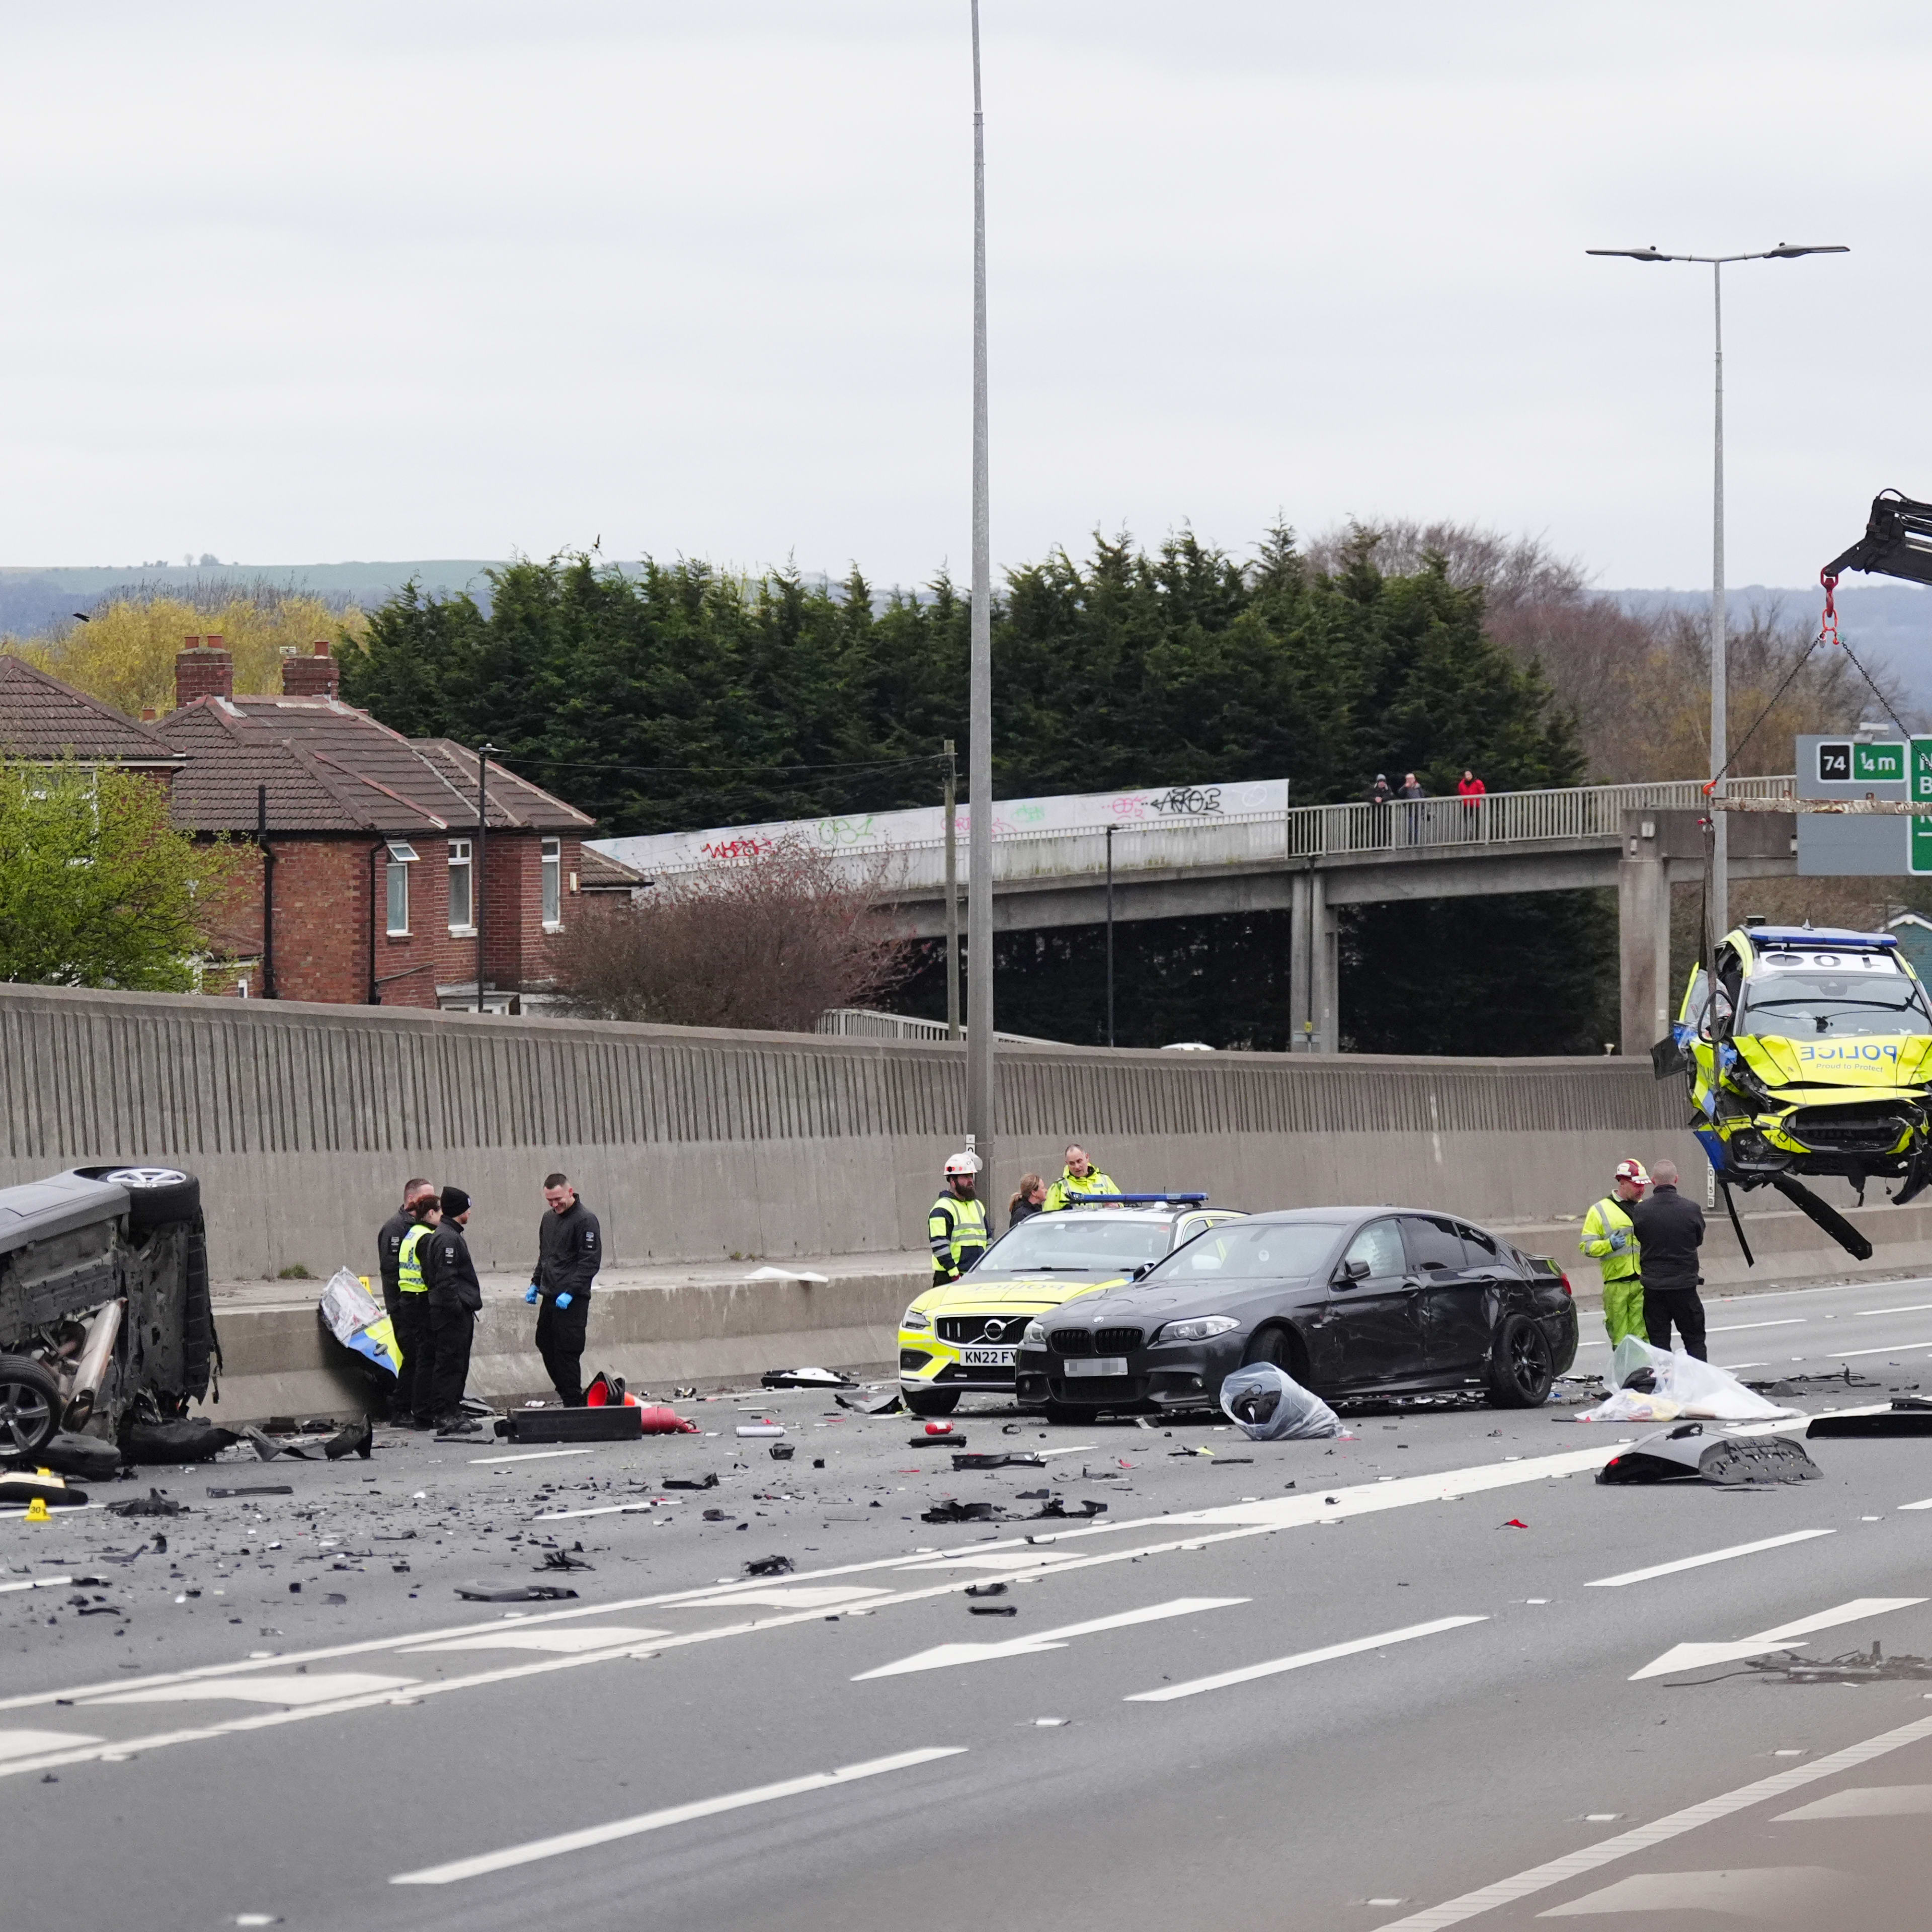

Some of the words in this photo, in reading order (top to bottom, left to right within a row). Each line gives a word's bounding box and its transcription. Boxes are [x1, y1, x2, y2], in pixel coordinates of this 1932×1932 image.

[1823, 756, 1846, 771] 74
[1855, 1064, 1883, 1072] Protect
[965, 1351, 998, 1363] KN22
